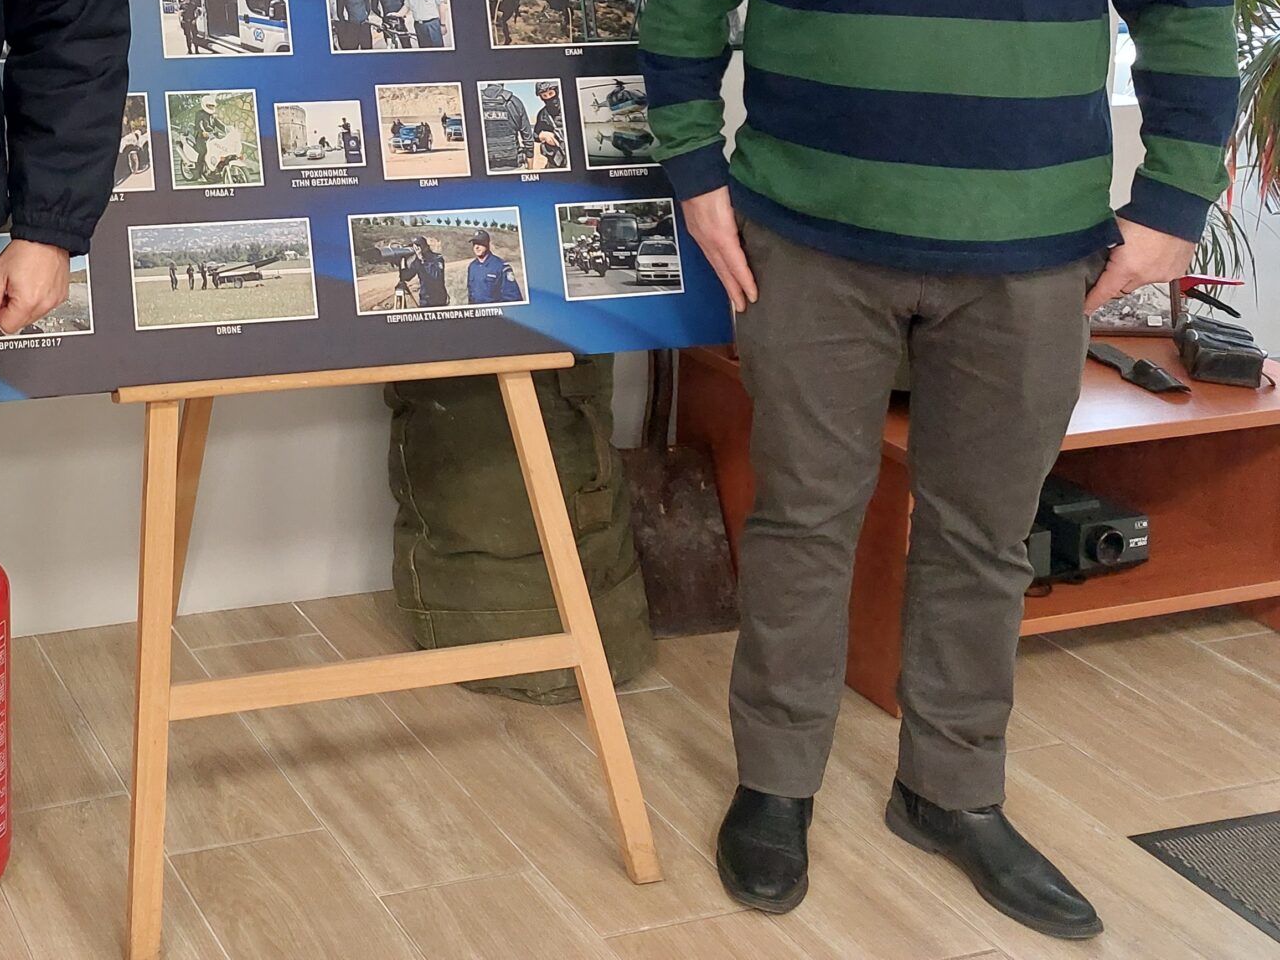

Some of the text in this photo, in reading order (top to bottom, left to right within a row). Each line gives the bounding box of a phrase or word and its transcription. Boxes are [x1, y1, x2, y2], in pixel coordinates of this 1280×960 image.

[301, 169, 348, 178] ΤΡΟΧΟΝΟΜΟΣ
[609, 168, 649, 178] ΕΛΙΚΟΠΤΕΡΟ
[291, 177, 359, 188] ΣΤΗΝ ΘΕΣΣΑΛΟΝΙΚΗ
[419, 178, 439, 187] ΕΚΑΜ
[521, 174, 540, 182] ΕΚΑΜ
[204, 189, 229, 198] ΟΜΑΔΑ
[387, 312, 423, 323] ΠΕΡΙΠΟΛΙΑ
[423, 312, 437, 321] ΣΤΑ
[463, 309, 474, 319] ΜΕ
[474, 307, 504, 317] ΔΙΟΠΤΡΑ
[216, 325, 242, 335] DRONE
[41, 338, 62, 347] 2017
